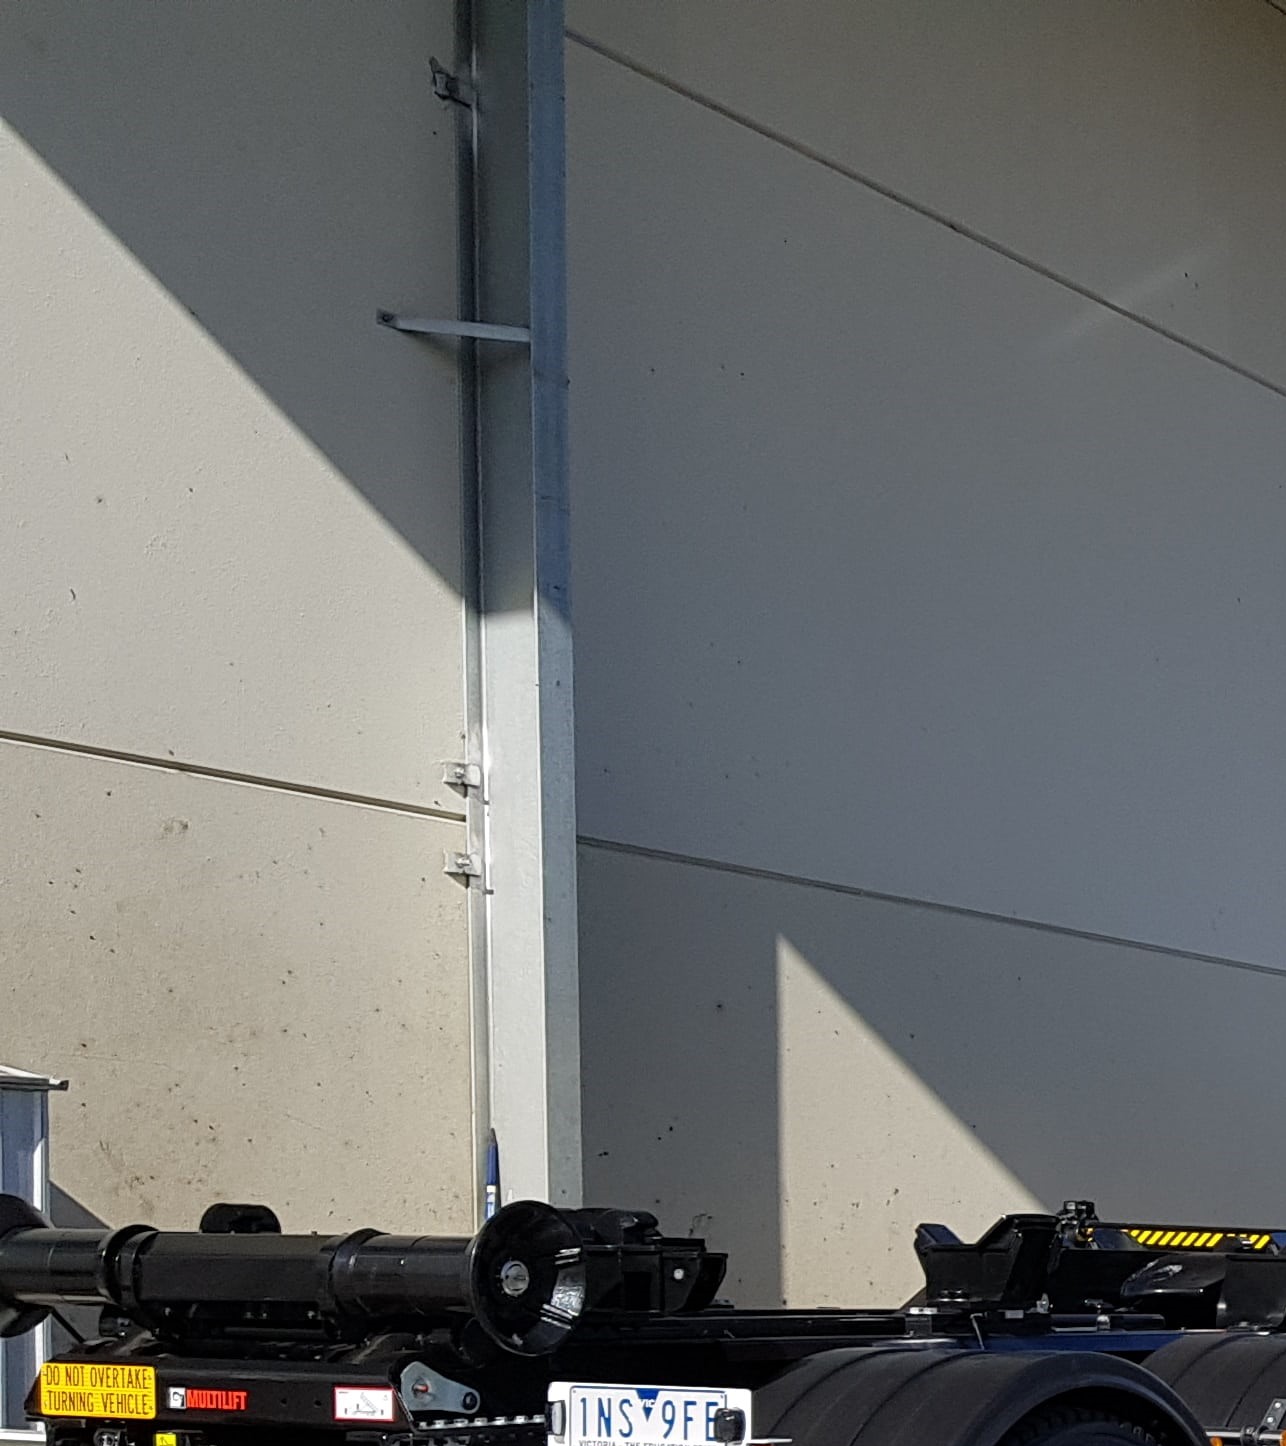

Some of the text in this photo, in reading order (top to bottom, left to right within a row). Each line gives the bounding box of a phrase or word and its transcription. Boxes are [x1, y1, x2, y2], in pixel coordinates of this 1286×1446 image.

[46, 1365, 150, 1390] DO NOT OVERTAKE
[47, 1390, 150, 1415] TURNING VEHICLE
[187, 1389, 247, 1410] MULTILIFT
